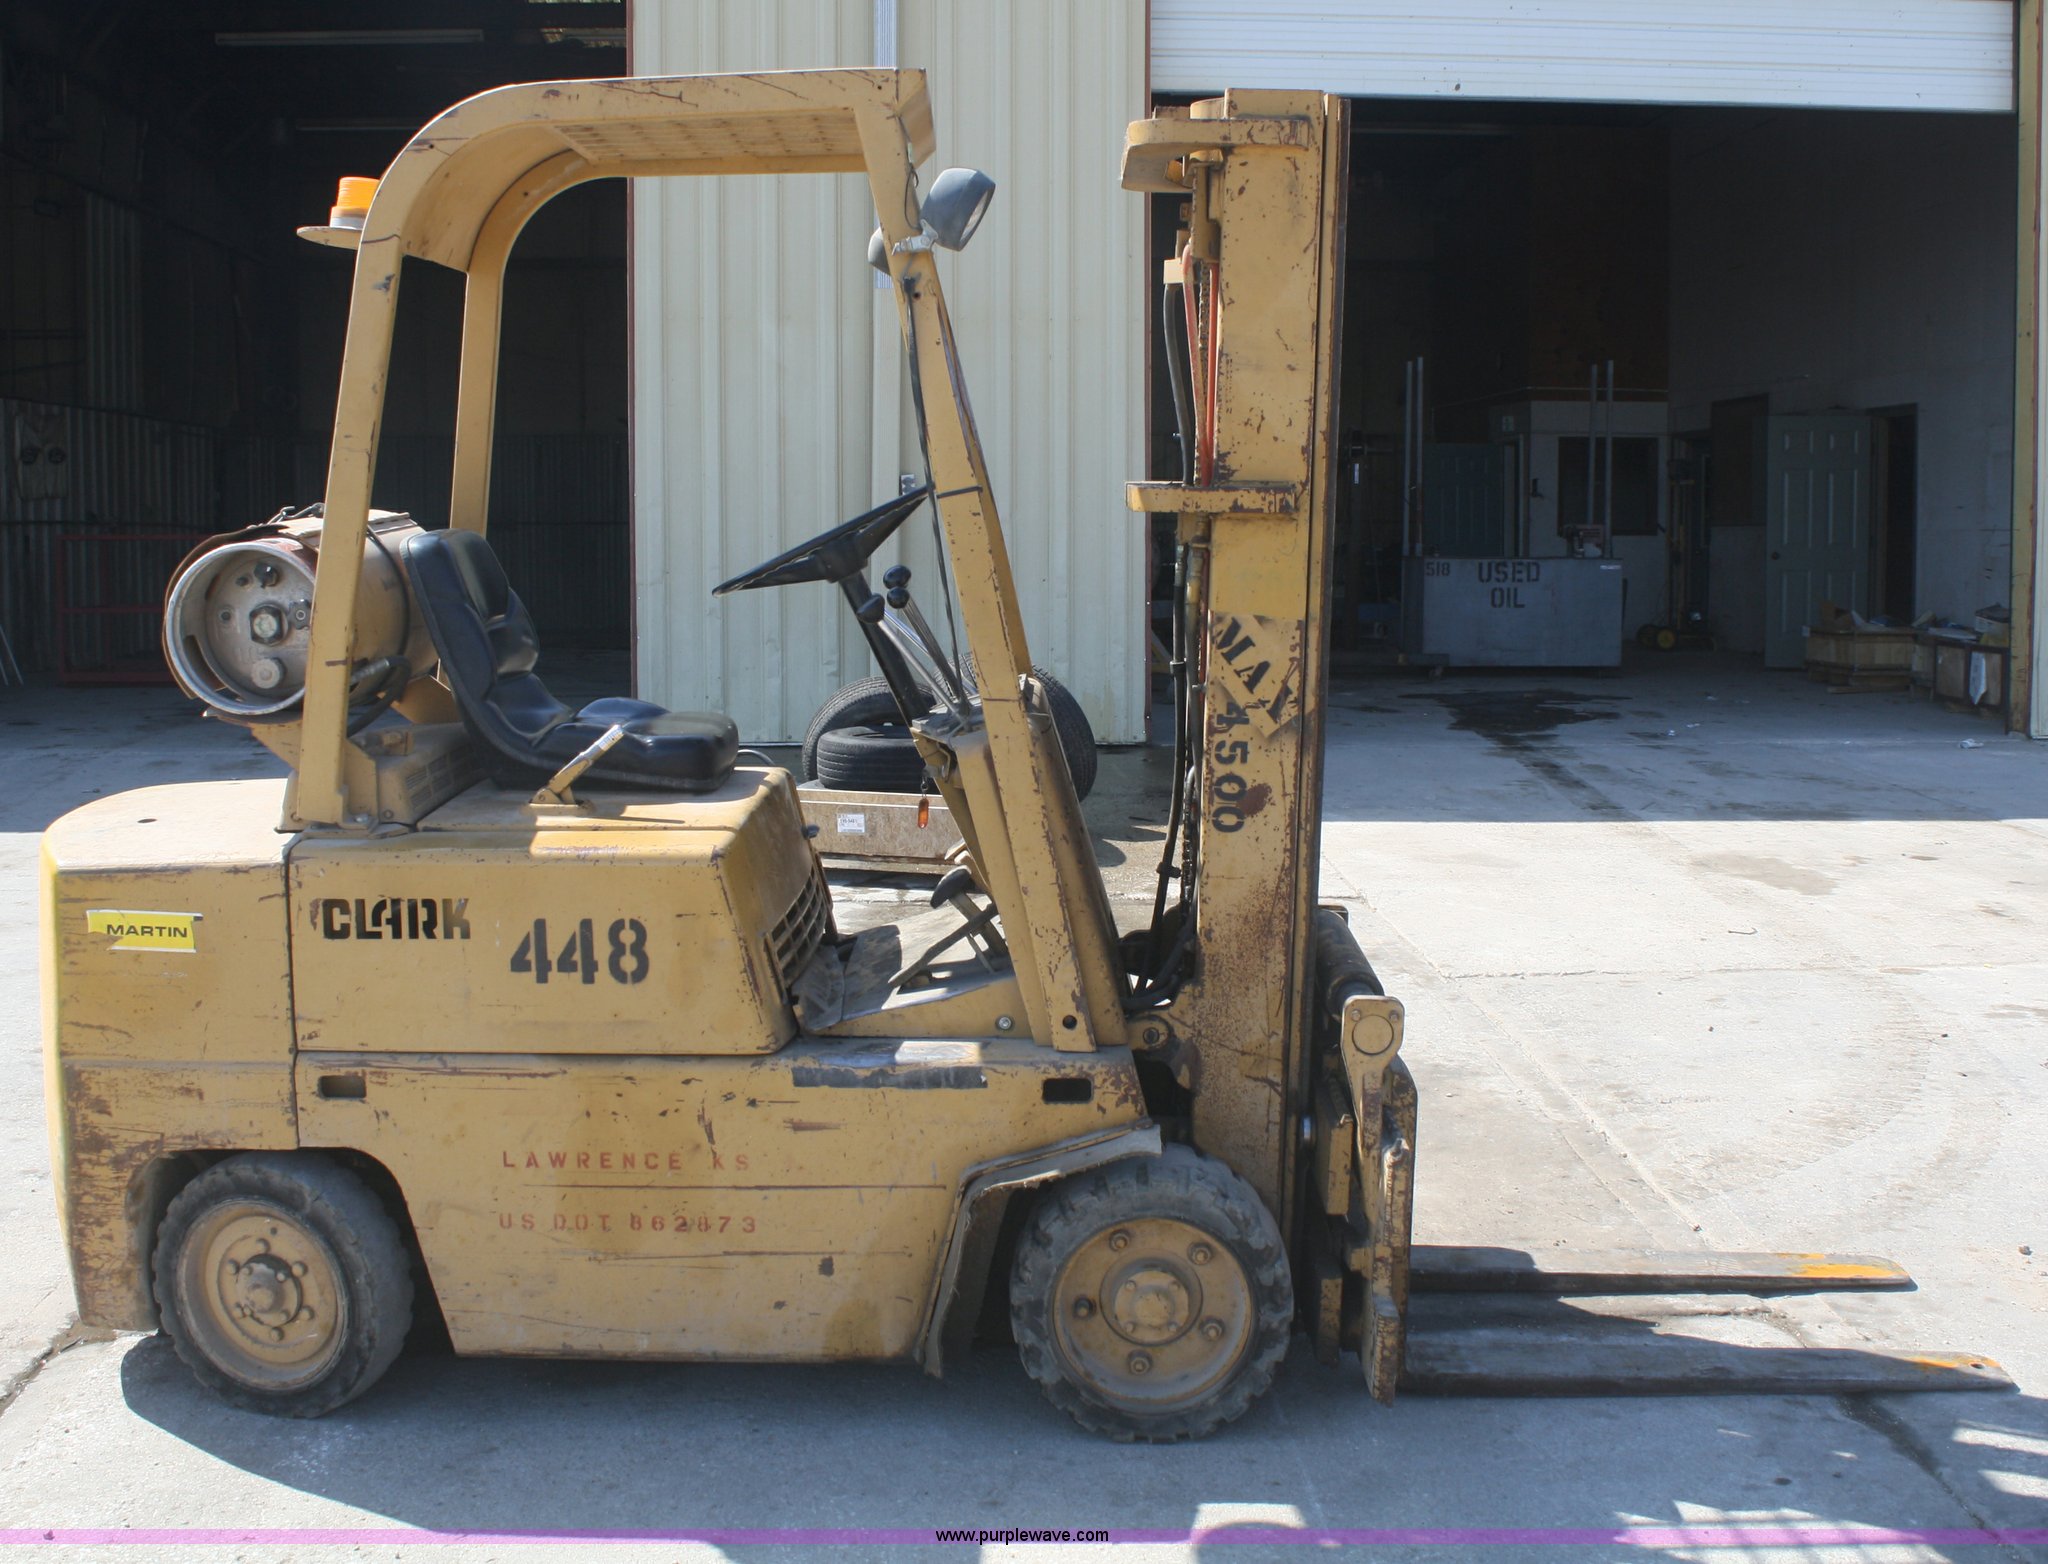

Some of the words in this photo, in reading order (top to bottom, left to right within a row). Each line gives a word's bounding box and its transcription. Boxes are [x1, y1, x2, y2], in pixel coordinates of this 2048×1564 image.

[1425, 561, 1450, 577] 518
[1477, 561, 1541, 583] USED
[1490, 587, 1526, 609] OIL
[1211, 701, 1250, 834] 4500
[321, 898, 471, 940] CLARK
[106, 924, 188, 938] MARTIN
[510, 917, 650, 985] 448
[502, 1150, 683, 1170] LAWRENCE
[713, 1153, 750, 1171] KS
[498, 1212, 536, 1230] US
[553, 1213, 611, 1232] DOT
